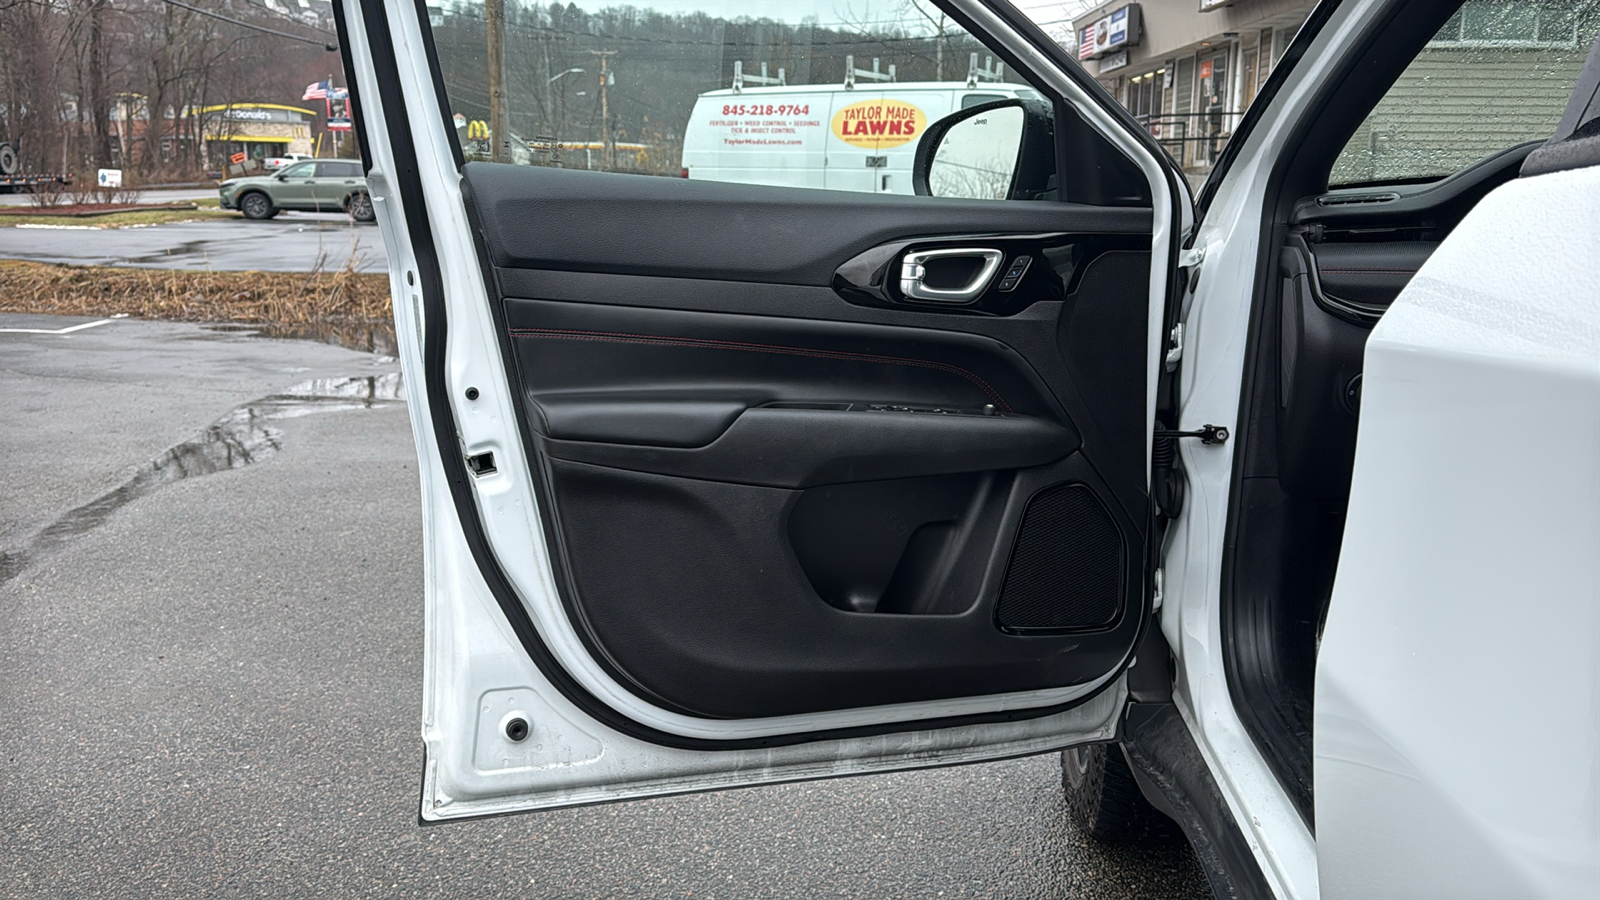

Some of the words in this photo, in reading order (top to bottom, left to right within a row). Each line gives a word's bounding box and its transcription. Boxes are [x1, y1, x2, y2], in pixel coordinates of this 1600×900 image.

[722, 105, 809, 115] 845-218-9764
[844, 106, 881, 120] TAYLOR
[886, 107, 915, 120] MADE
[842, 120, 915, 136] LAWNS
[723, 138, 802, 146] TaylorMadeLawns.com
